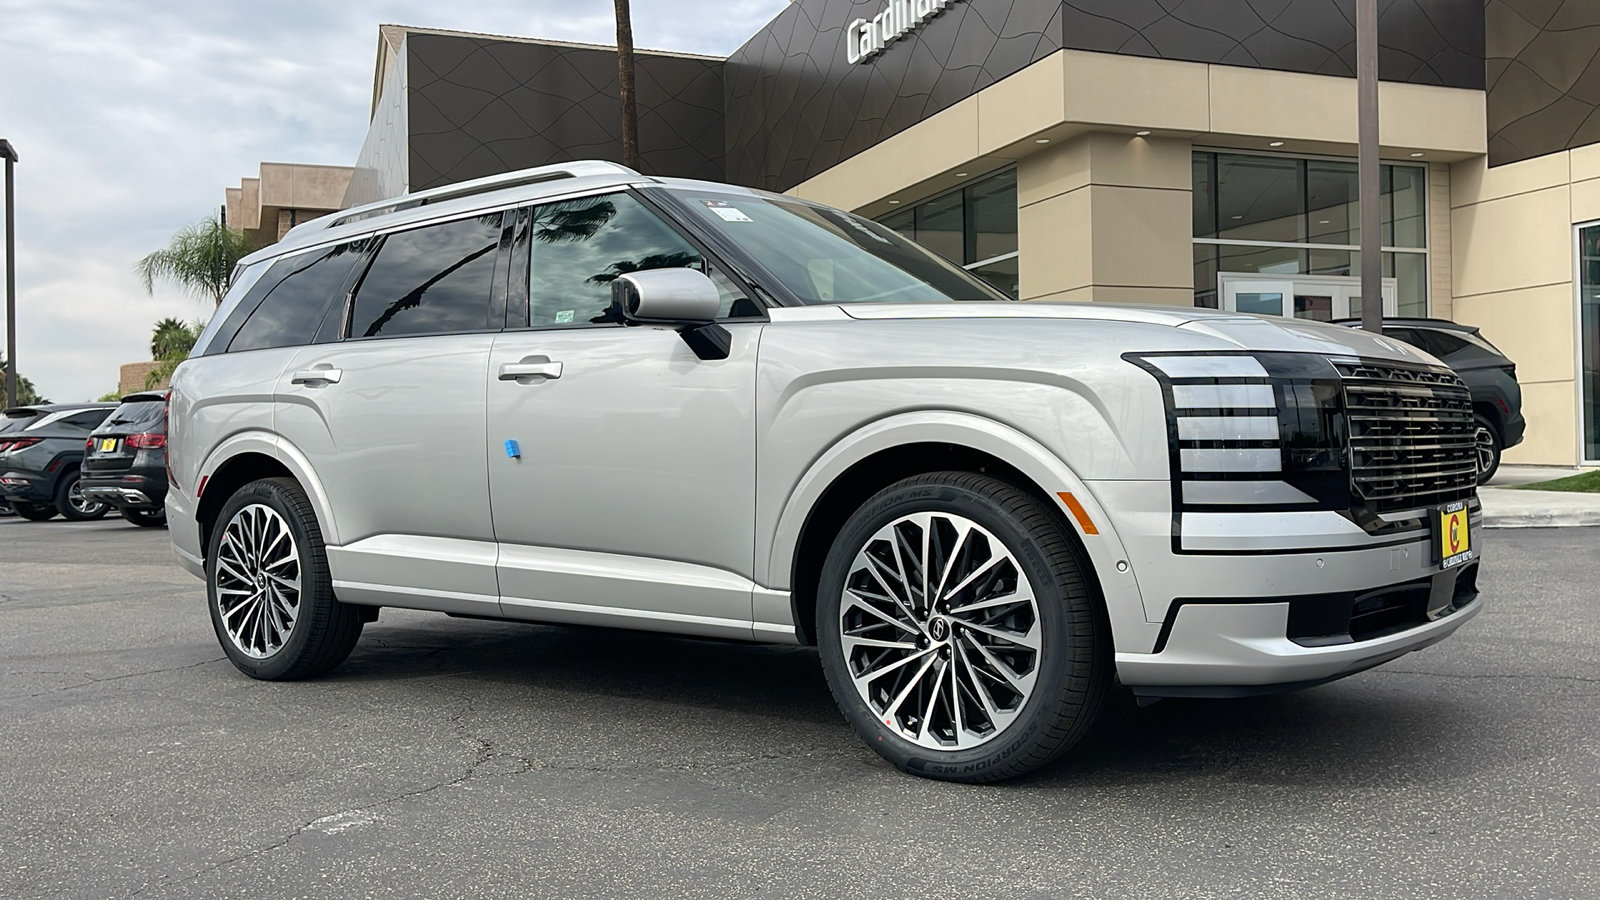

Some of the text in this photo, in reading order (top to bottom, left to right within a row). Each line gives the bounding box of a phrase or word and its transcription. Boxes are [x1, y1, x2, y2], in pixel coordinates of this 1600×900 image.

[909, 489, 933, 499] MS
[933, 721, 1038, 775] SCORPION MS
